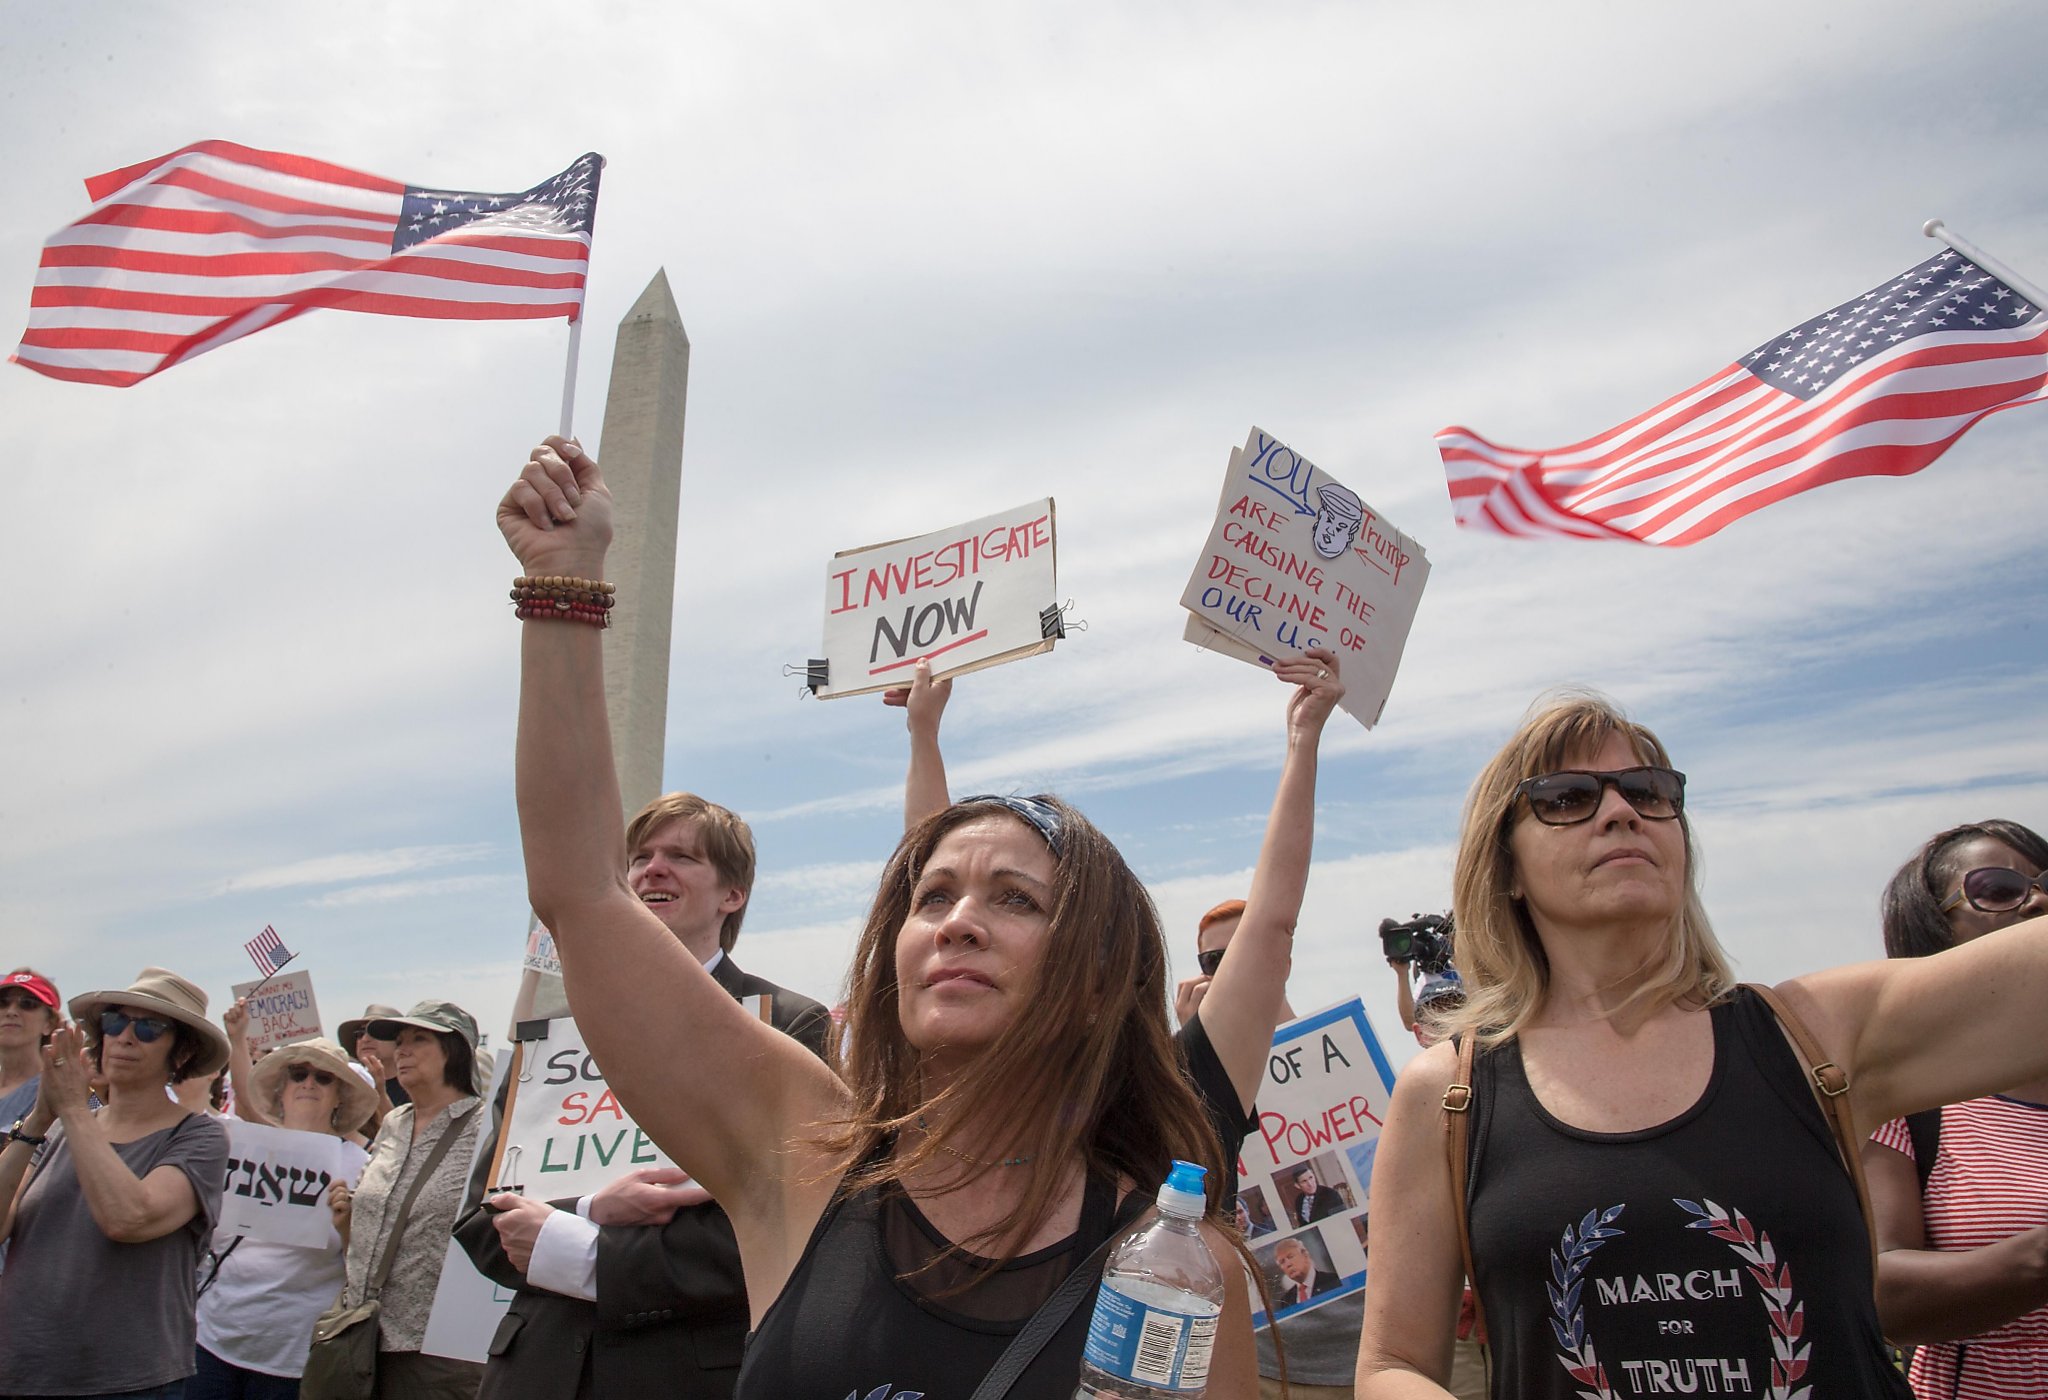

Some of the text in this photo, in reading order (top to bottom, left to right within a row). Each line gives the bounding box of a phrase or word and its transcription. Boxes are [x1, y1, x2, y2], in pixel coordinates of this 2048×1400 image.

[1251, 434, 1314, 502] YOU
[1230, 495, 1290, 533] ARE
[831, 515, 1050, 614] INVESTIGATE
[1359, 507, 1410, 586] Trump
[1223, 522, 1376, 626] CAUSING THE
[869, 580, 984, 663] NOW
[1201, 587, 1262, 632] OUR
[1208, 555, 1366, 651] DECLINE OF
[247, 990, 309, 1019] EMOCRACY
[262, 1012, 298, 1034] BACK
[1269, 1034, 1351, 1084] OF A
[1259, 1096, 1383, 1165] POWER
[1595, 1269, 1742, 1306] MARCH
[1658, 1320, 1694, 1335] FOR
[1621, 1358, 1752, 1394] TRUTH
